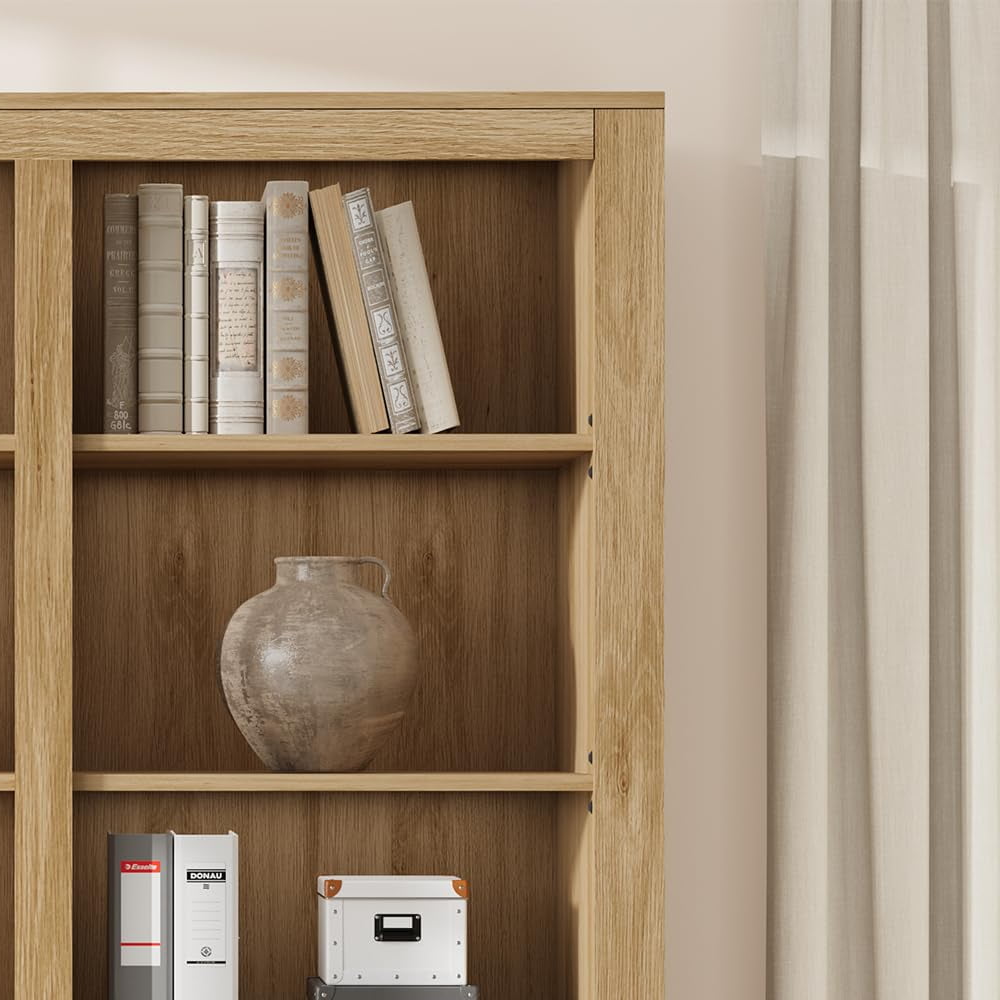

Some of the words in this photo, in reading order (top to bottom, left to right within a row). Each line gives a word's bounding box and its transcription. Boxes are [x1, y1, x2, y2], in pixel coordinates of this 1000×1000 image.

[119, 401, 125, 409] F
[113, 410, 128, 420] 800
[190, 872, 222, 880] DONAU
